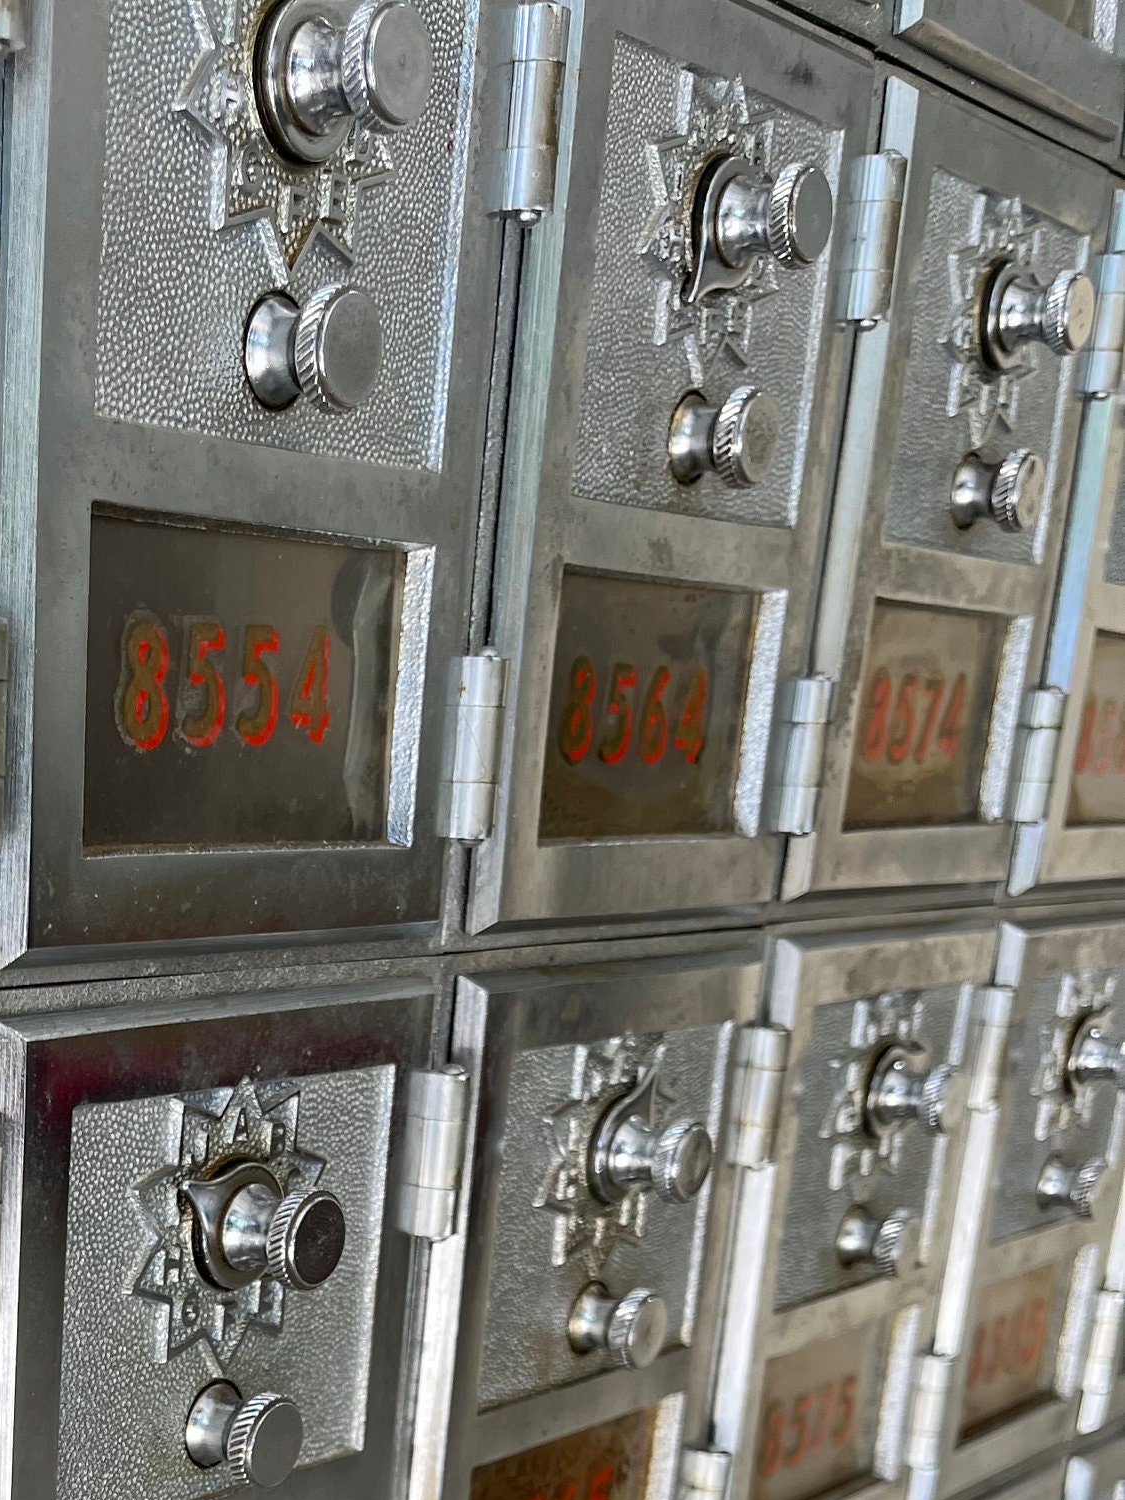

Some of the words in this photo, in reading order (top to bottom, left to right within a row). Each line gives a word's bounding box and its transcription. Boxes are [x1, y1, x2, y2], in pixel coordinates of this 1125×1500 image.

[123, 622, 331, 750] 8554
[559, 655, 707, 767] 8564
[862, 665, 967, 765] 8574
